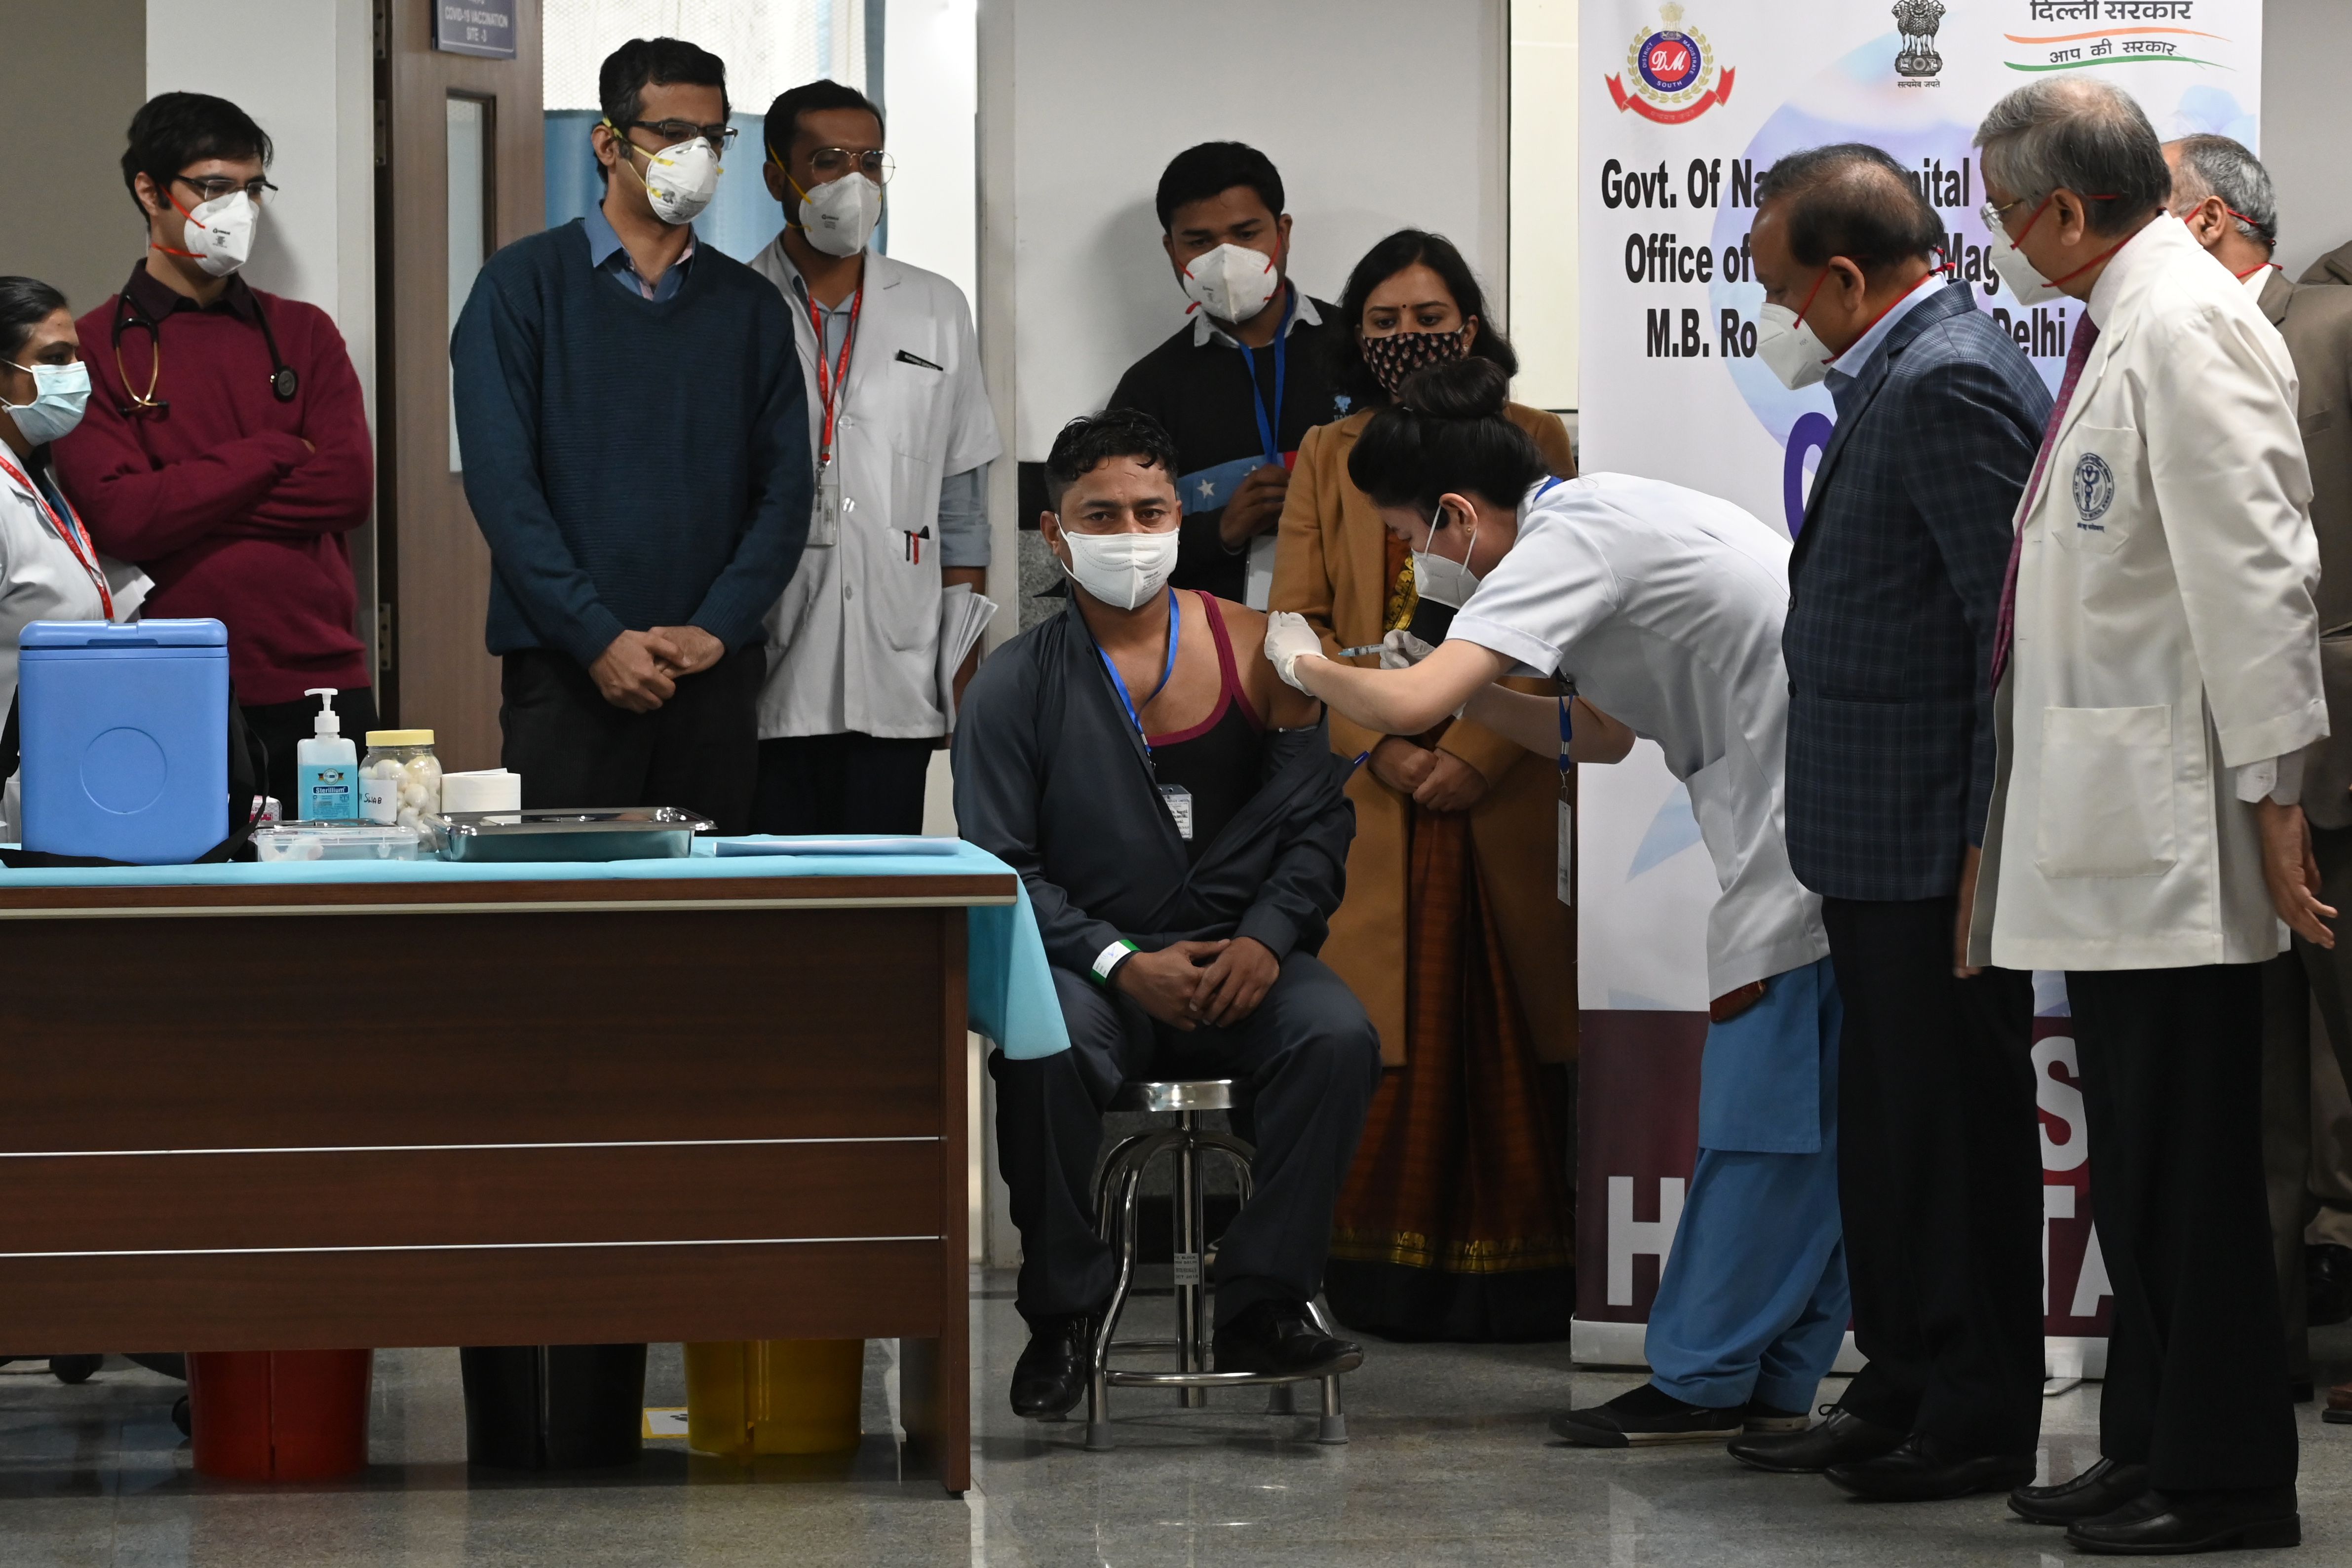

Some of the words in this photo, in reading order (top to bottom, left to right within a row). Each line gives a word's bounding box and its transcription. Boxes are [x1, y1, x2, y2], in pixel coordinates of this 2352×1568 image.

[2104, 1, 2193, 20] सरकार
[1642, 42, 1654, 68] DISTRICT
[1651, 50, 1688, 71] DM
[1682, 39, 1697, 75] MAGISTRATE
[2049, 48, 2081, 63] आप
[2090, 38, 2112, 56] की
[2122, 40, 2177, 56] सरकार
[1657, 80, 1683, 88] SOUTH
[1897, 79, 1922, 88] सत्यमेव
[1924, 79, 1940, 88] जयते
[1602, 158, 1677, 209] Govt.
[1687, 158, 1721, 209] Of
[1625, 233, 1713, 283] Office
[1723, 232, 1751, 283] of
[1647, 308, 1709, 357] M.B.
